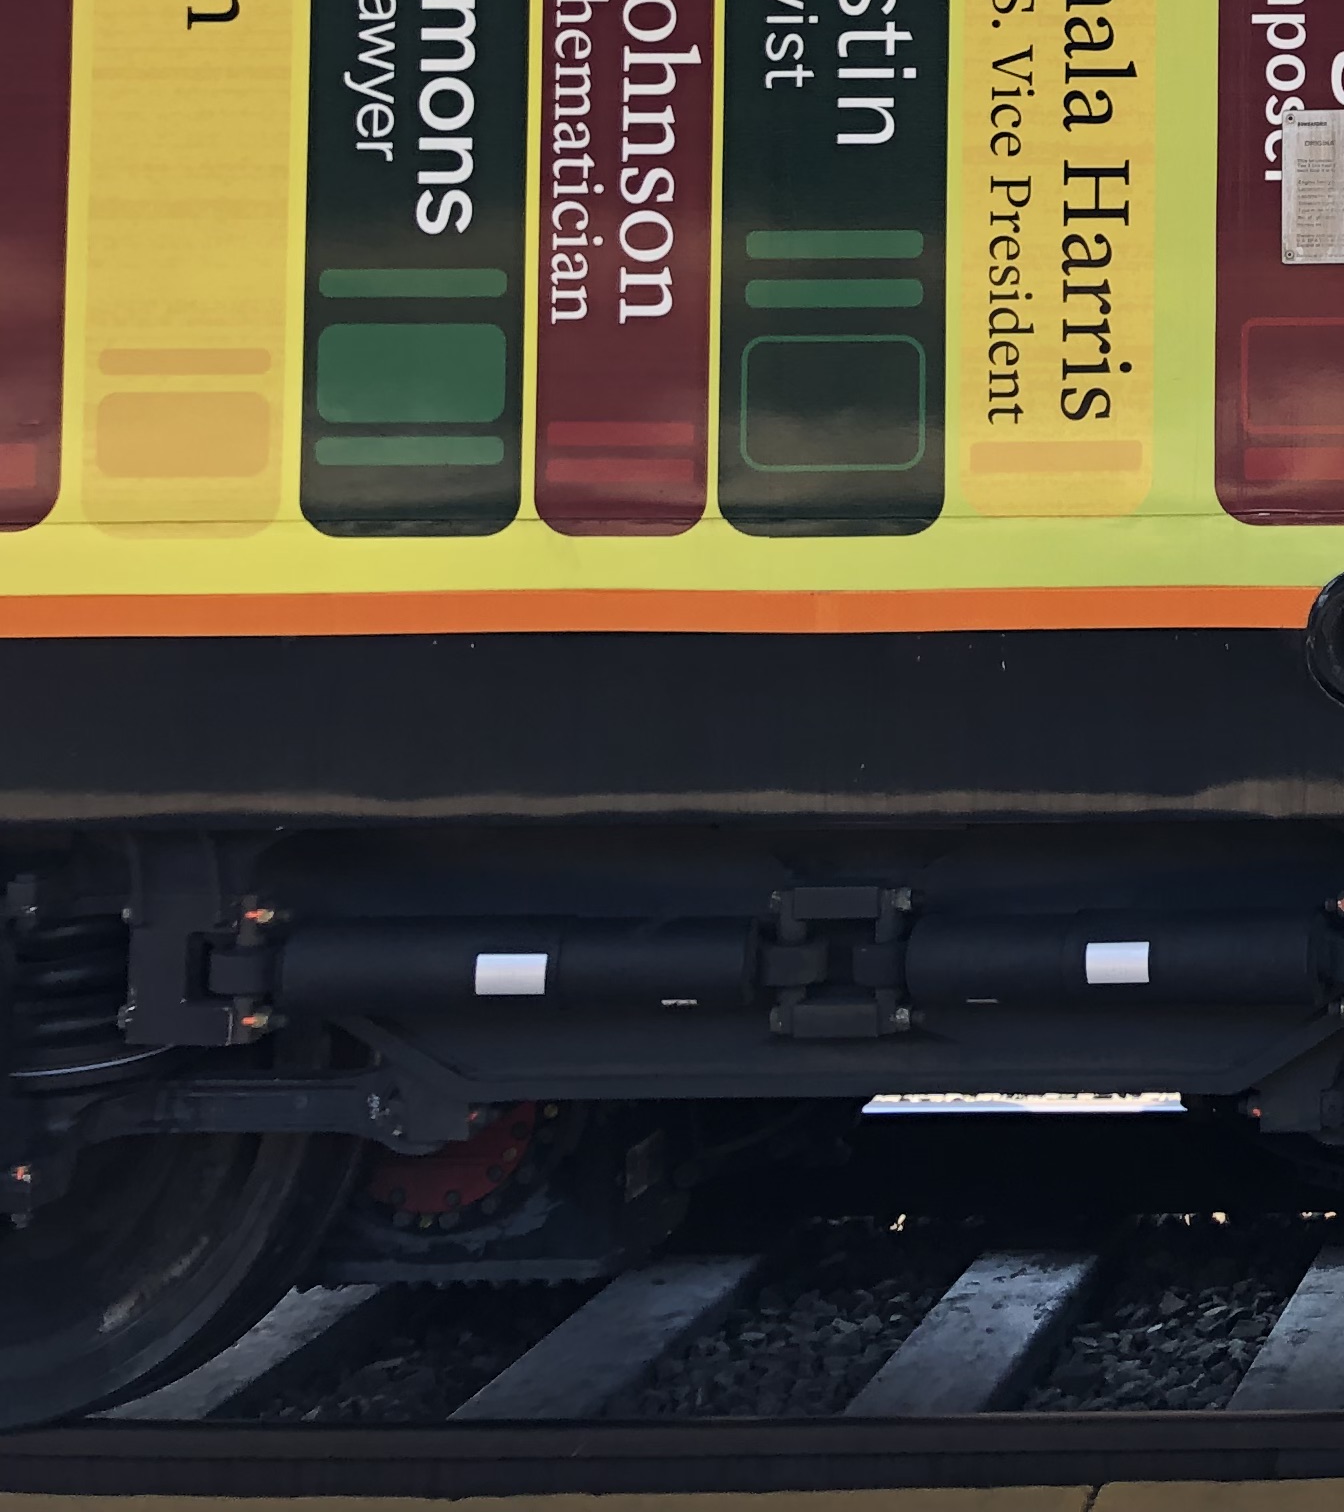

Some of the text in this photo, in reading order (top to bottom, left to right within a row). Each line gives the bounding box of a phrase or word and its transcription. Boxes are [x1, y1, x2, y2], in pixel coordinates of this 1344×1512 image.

[989, 44, 1035, 157] Vice
[987, 175, 1035, 425] President
[1060, 159, 1133, 421] Harris
